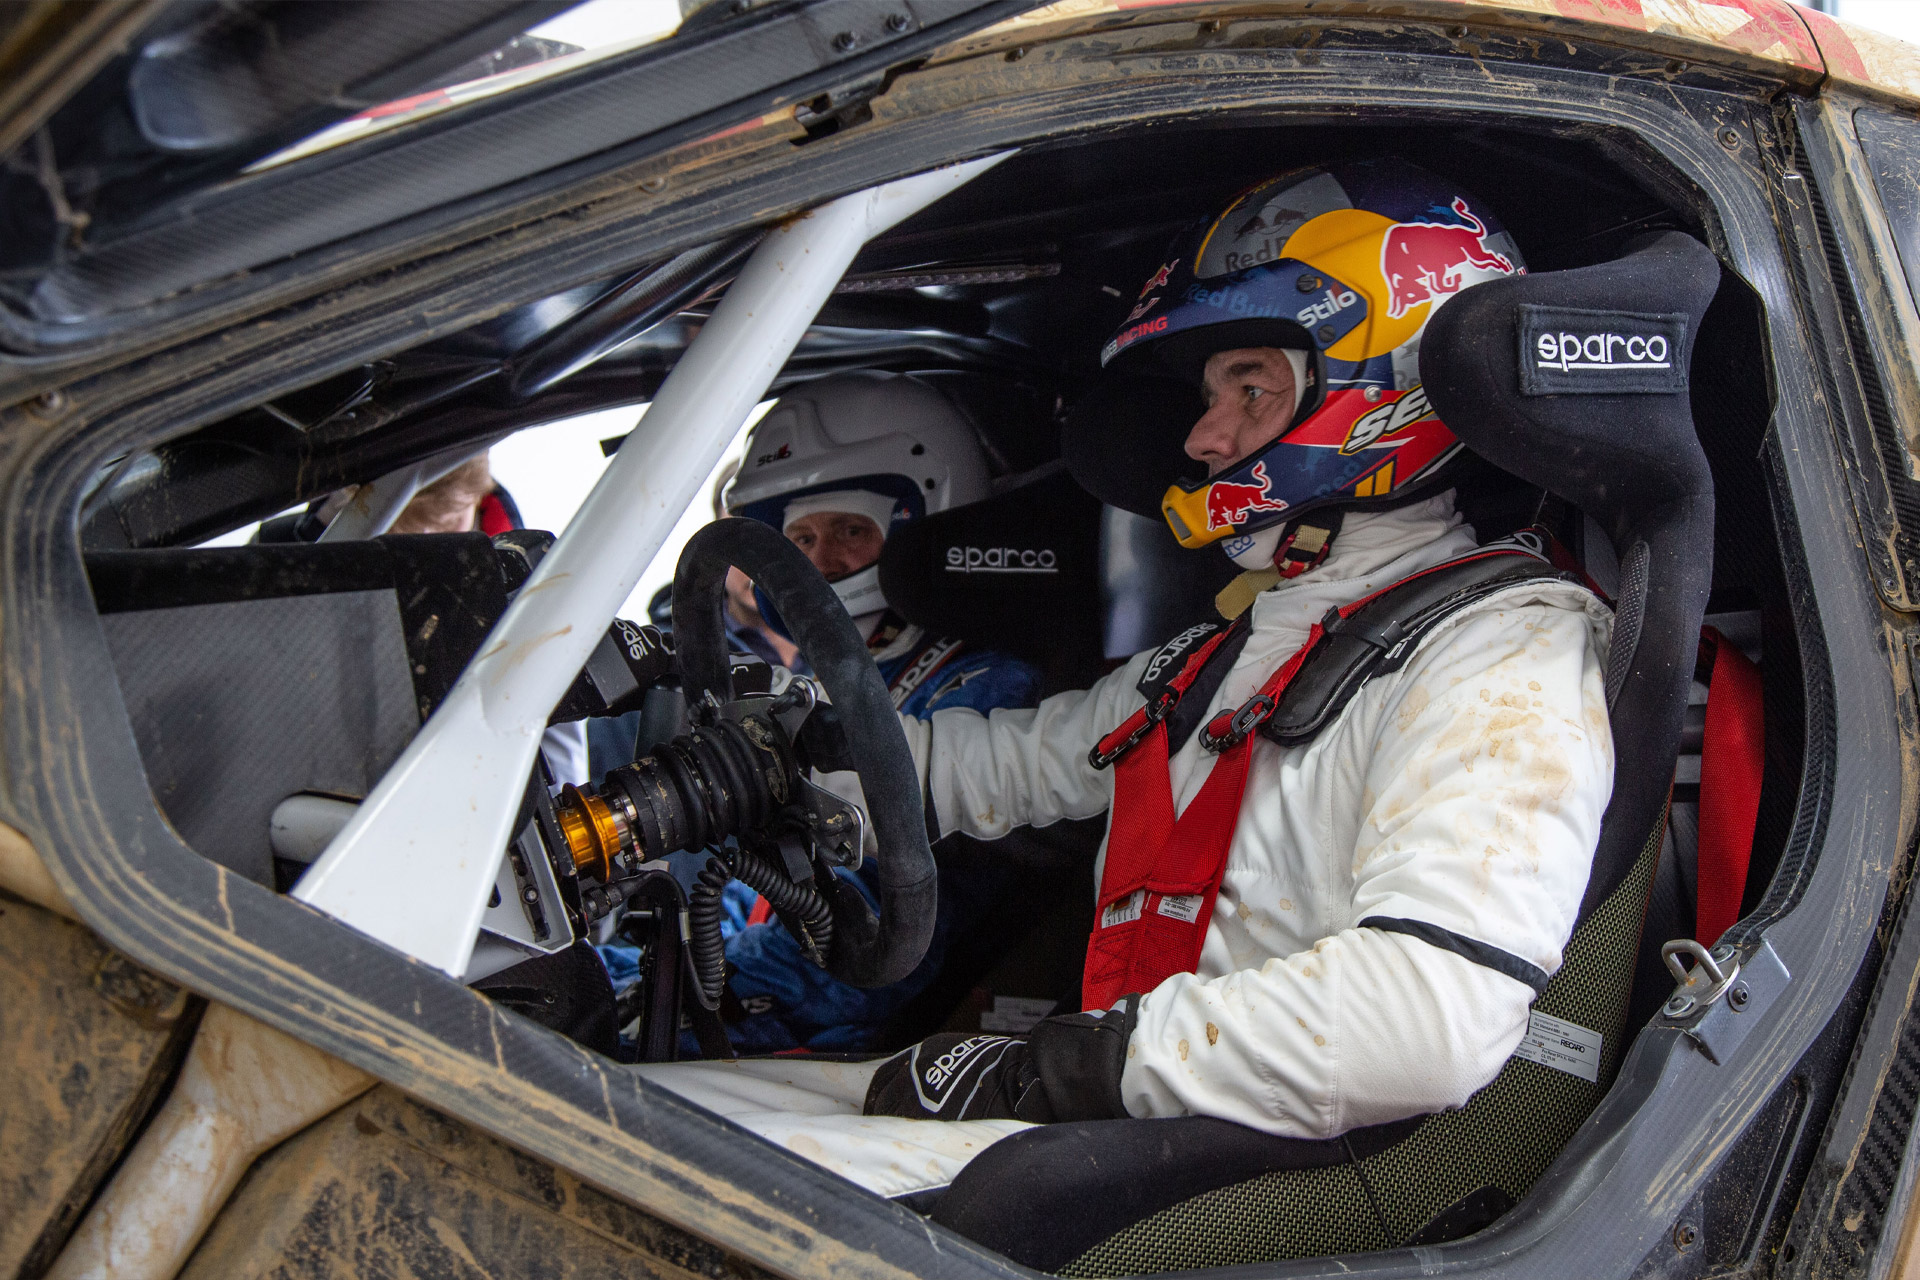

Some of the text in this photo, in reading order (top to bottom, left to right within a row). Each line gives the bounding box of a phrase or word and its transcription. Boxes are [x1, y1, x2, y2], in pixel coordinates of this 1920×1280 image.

[1296, 282, 1358, 328] Stilo
[1537, 332, 1671, 372] sparco
[1344, 386, 1434, 452] SE
[945, 546, 1059, 573] sparco
[1224, 535, 1256, 558] rco
[613, 620, 650, 660] spa
[1143, 623, 1218, 684] sparco
[890, 637, 955, 706] spar
[1560, 1039, 1586, 1053] RECARO
